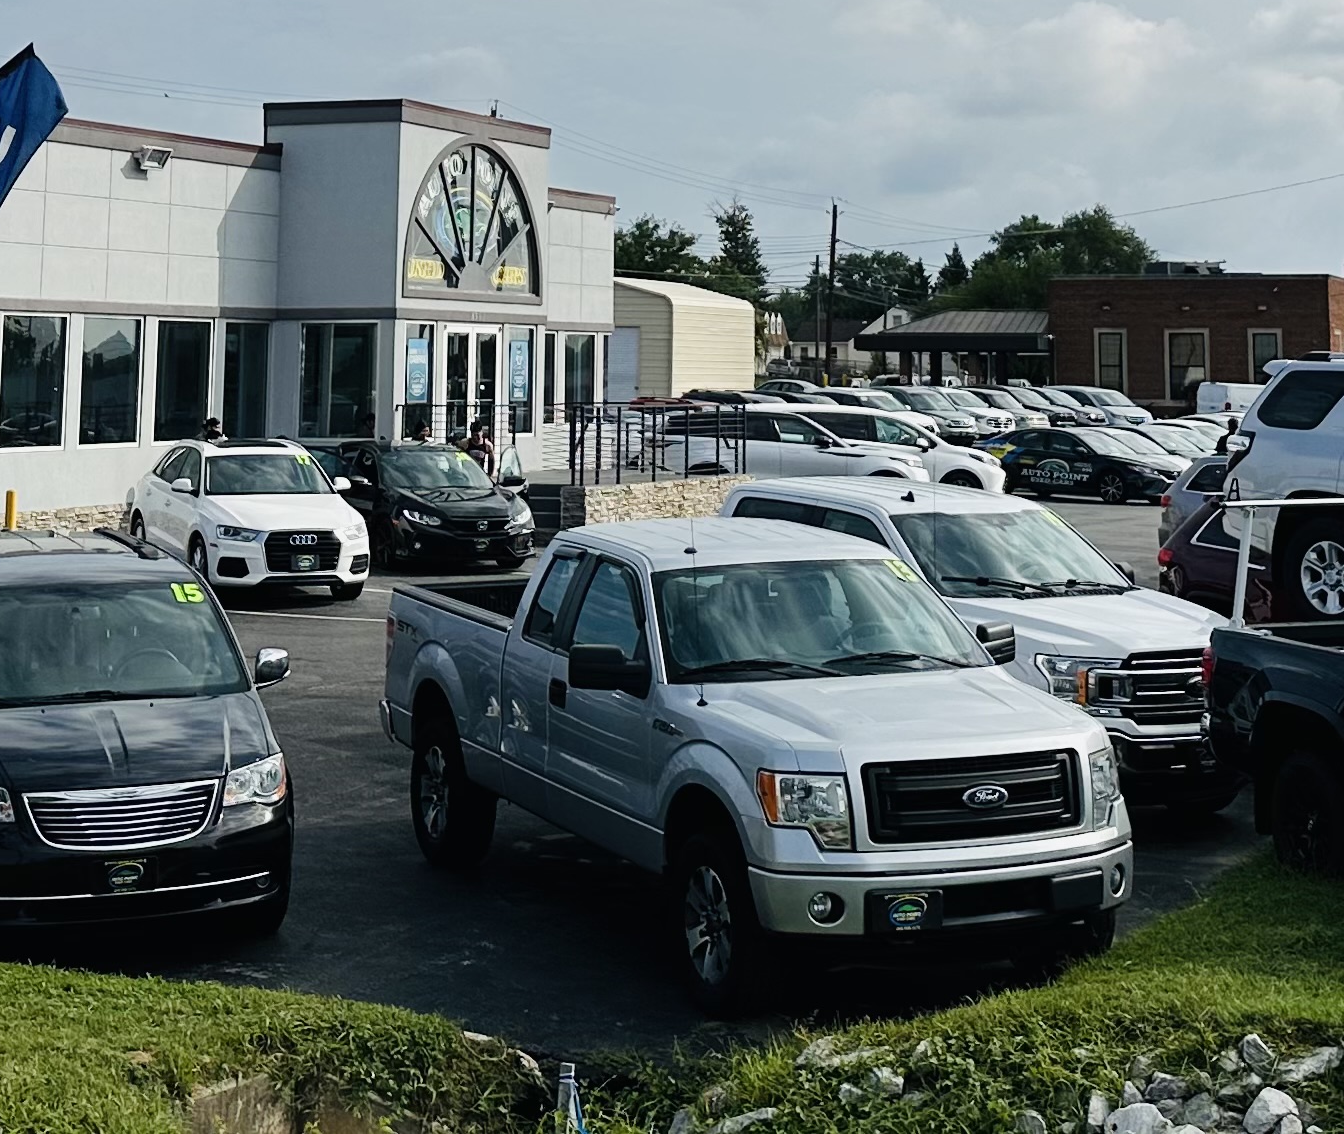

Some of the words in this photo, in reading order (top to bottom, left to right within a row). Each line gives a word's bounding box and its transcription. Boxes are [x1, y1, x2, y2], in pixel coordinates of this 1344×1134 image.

[1021, 468, 1052, 478] AUTO
[1053, 470, 1090, 482] POINT
[170, 583, 205, 603] 15
[975, 790, 1000, 803] Ford
